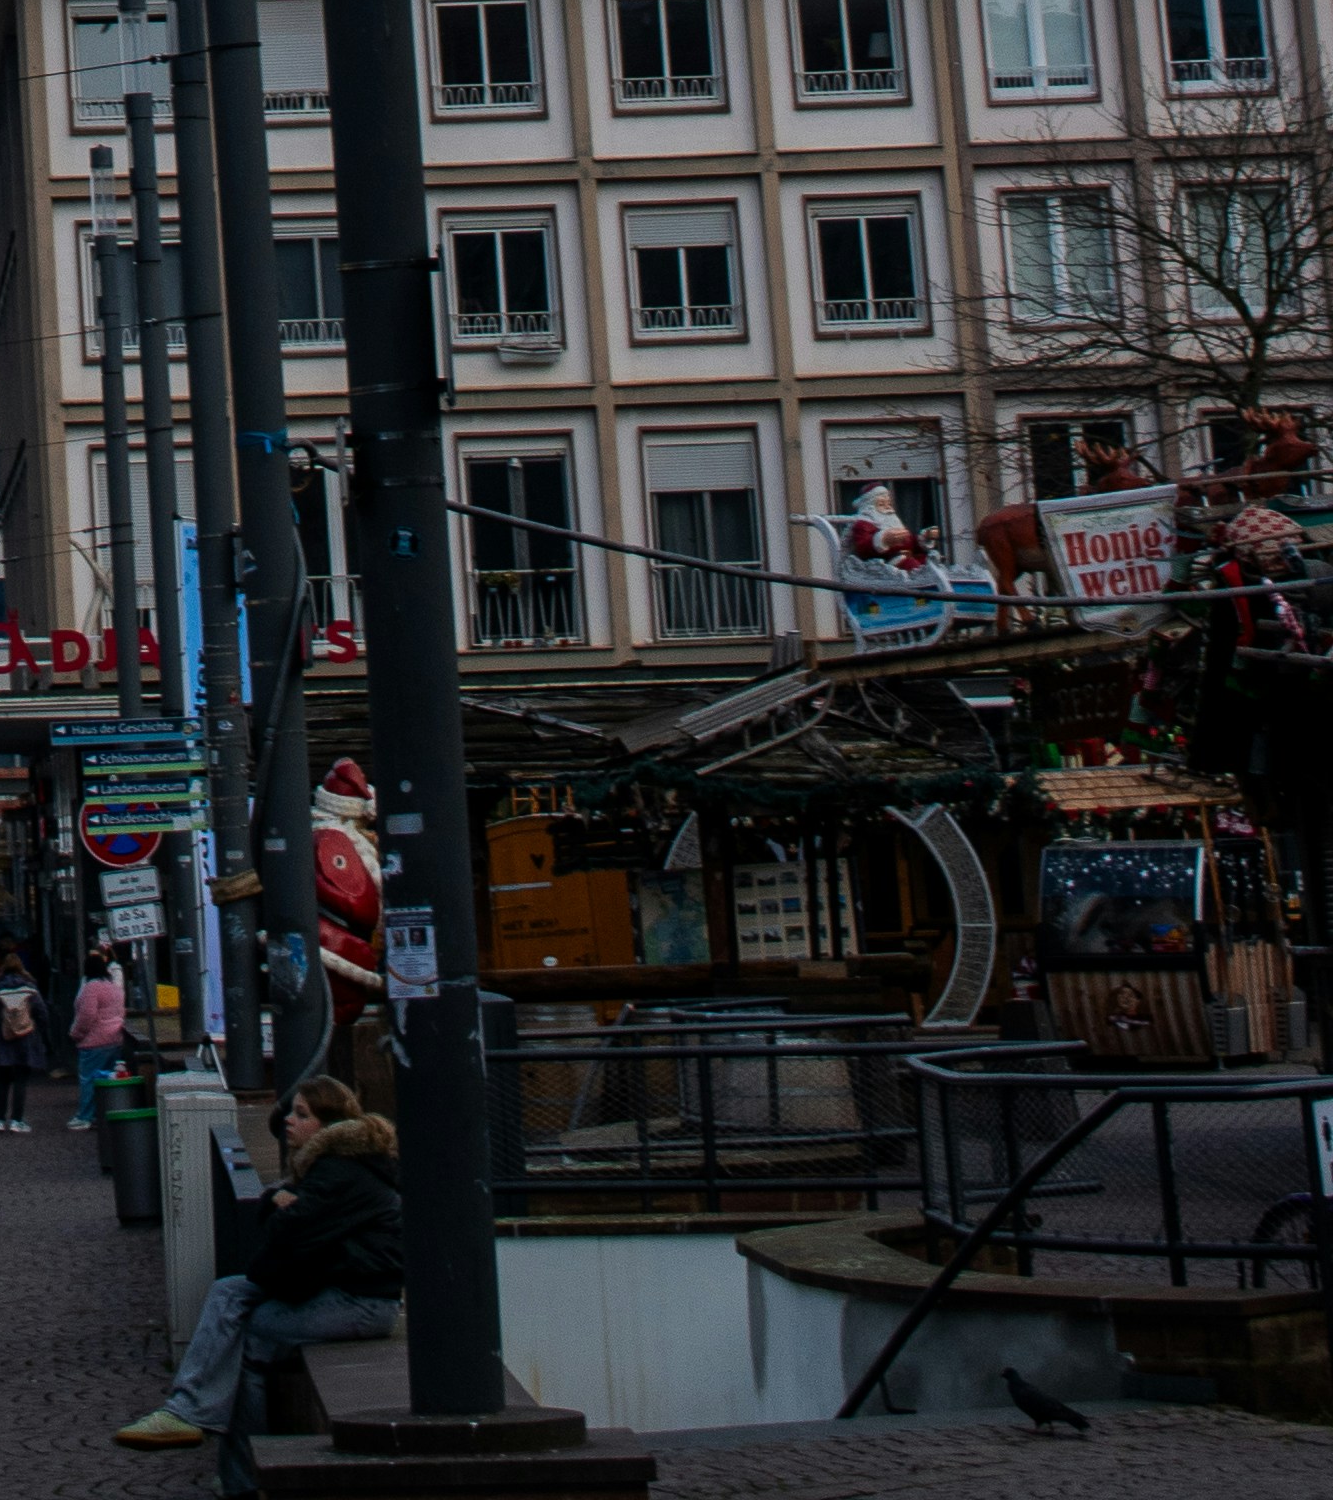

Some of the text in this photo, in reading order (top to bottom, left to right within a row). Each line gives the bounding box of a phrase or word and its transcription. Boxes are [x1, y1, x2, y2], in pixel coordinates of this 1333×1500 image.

[1063, 522, 1174, 567] Honig-
[1079, 561, 1162, 597] wein
[71, 722, 175, 735] Haus der Geschichte
[99, 752, 187, 765] Schlossmuseum
[100, 782, 187, 795] Landesmuseum
[102, 810, 186, 825] Residenzschl
